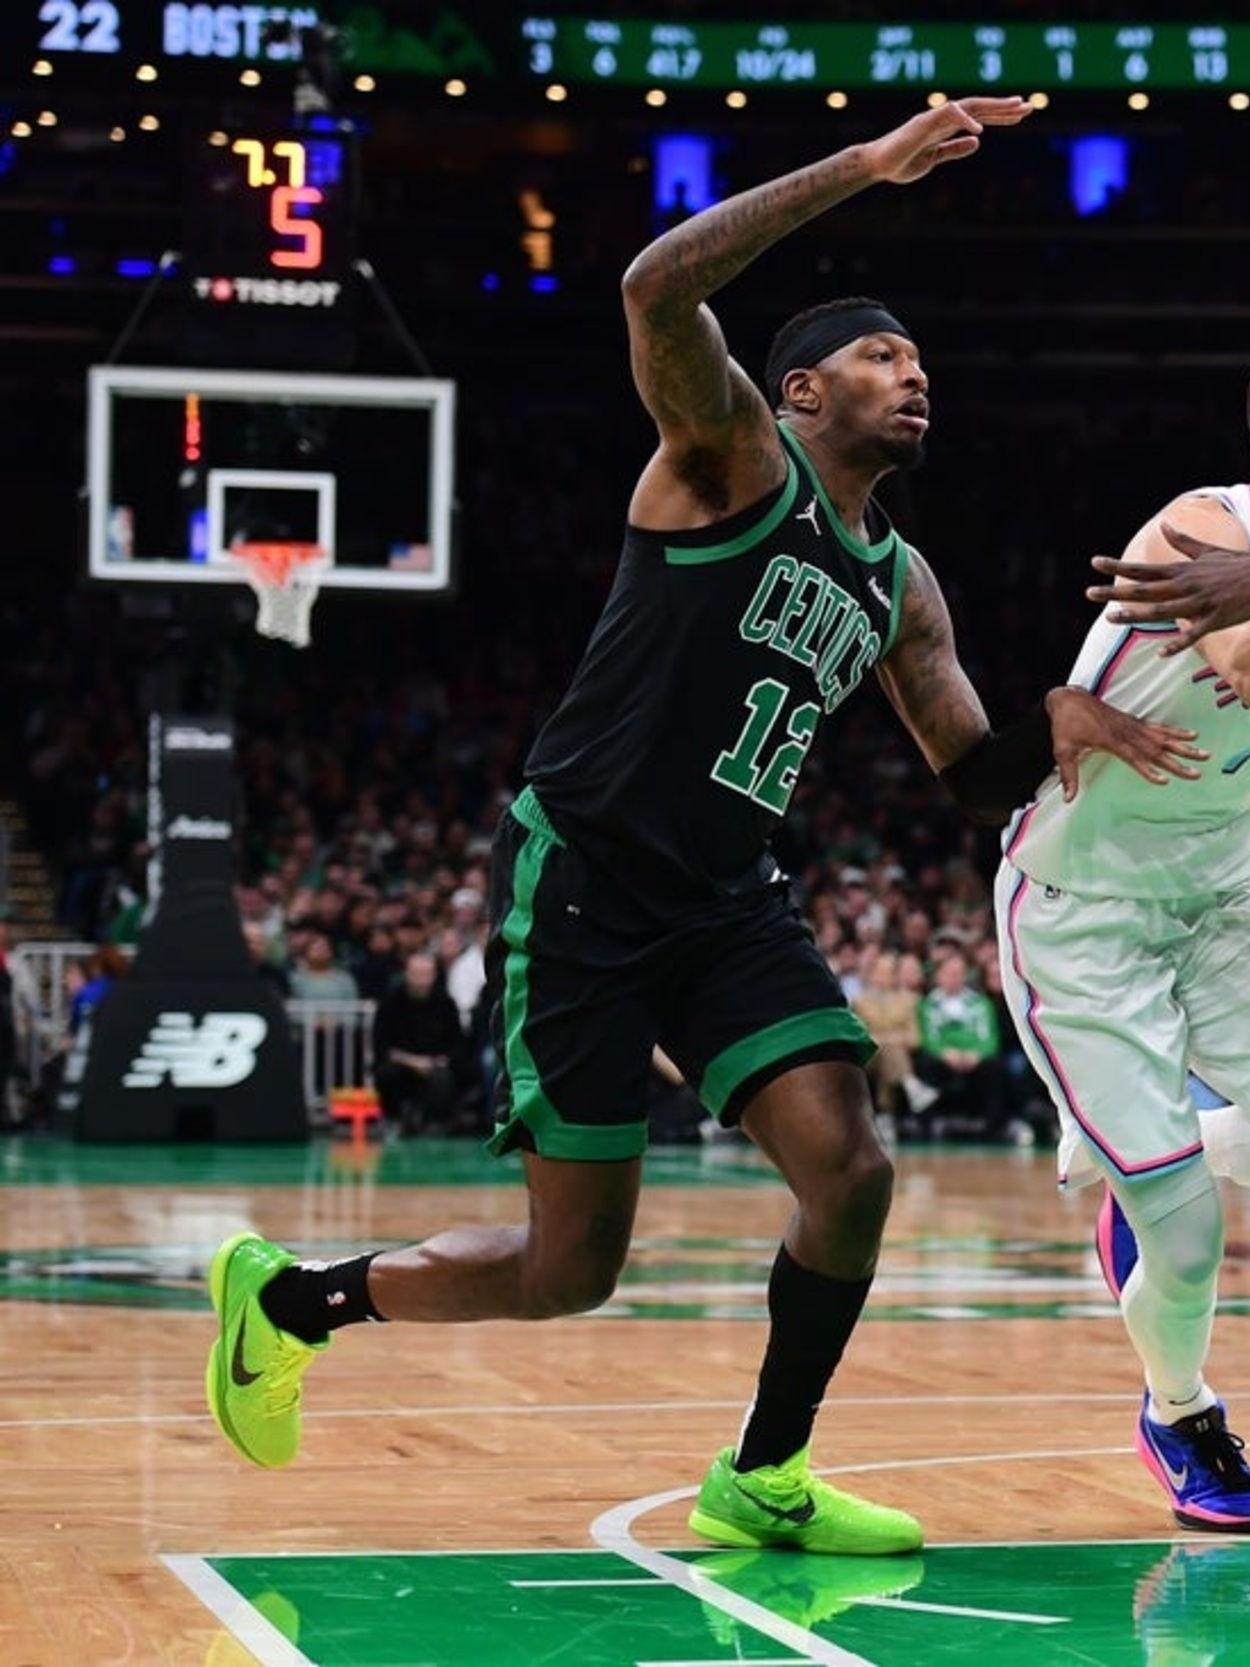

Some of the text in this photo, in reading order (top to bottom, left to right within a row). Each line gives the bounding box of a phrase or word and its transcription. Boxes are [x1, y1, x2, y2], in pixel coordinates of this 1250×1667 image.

[38, 0, 120, 52] 22
[270, 186, 323, 269] 5
[738, 554, 882, 716] CELTICS
[710, 677, 822, 817] 12
